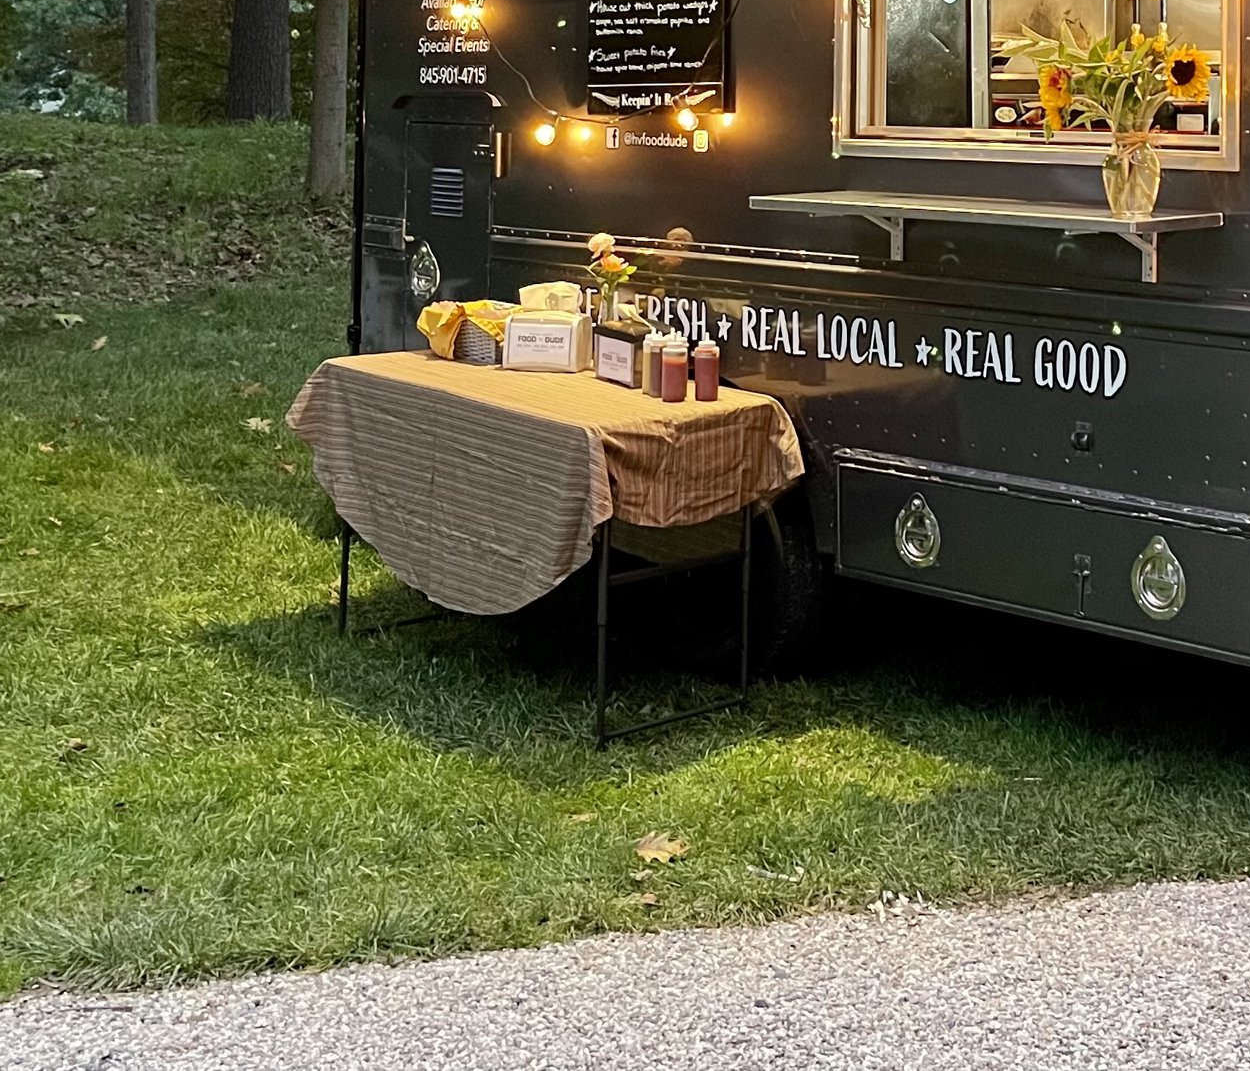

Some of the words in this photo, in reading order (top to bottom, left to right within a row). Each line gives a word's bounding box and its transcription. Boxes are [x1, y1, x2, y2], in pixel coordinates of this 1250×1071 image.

[418, 36, 453, 56] Special
[455, 36, 489, 53] Events
[420, 66, 487, 85] 845-901-4715
[621, 93, 653, 109] Keepin'
[624, 132, 688, 148] @hvfooddude
[518, 335, 537, 343] FOOD
[545, 336, 564, 344] DUDE
[635, 293, 708, 341] FRESH
[741, 305, 806, 356] REAL
[817, 313, 903, 367] LOCAL
[944, 328, 1021, 383] REAL
[1034, 338, 1127, 397] GOOD
